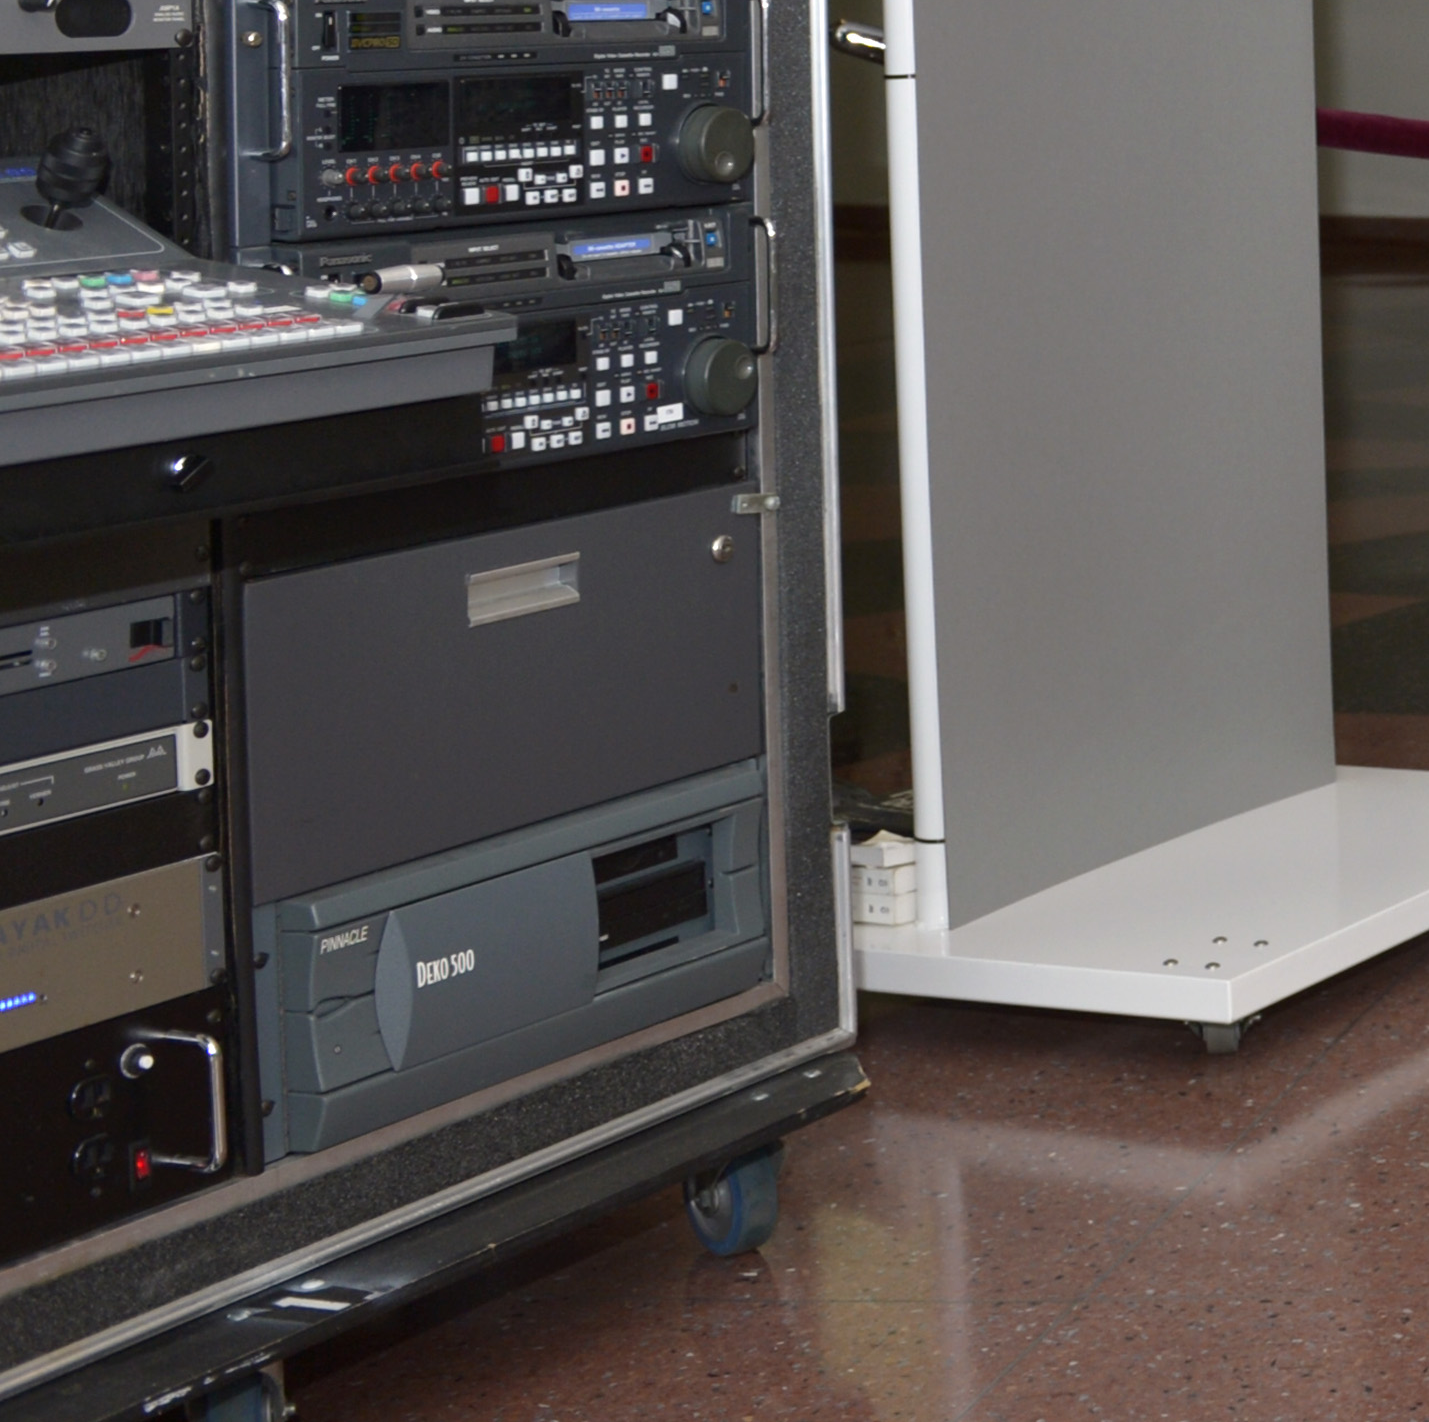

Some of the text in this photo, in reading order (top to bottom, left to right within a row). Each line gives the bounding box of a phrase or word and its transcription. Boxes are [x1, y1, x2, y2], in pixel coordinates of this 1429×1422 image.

[319, 253, 373, 267] Panasonic
[319, 925, 370, 956] PINNACLE
[415, 948, 476, 989] DEKO 500
